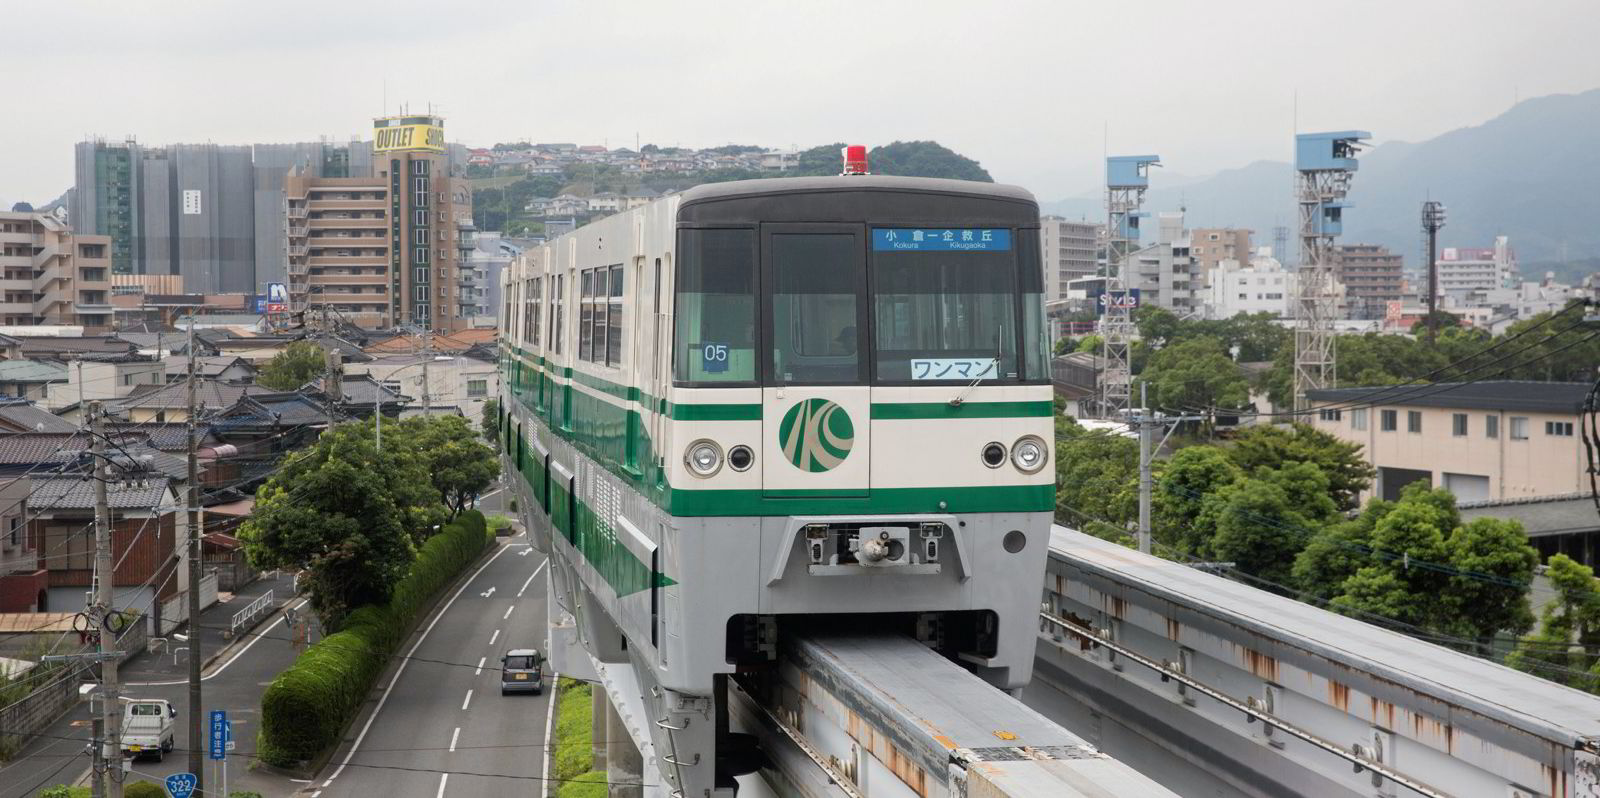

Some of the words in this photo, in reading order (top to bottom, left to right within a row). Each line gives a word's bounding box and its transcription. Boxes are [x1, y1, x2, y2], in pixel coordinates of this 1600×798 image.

[376, 127, 415, 149] OUTLET
[893, 241, 919, 249] Kokura
[949, 241, 986, 250] Kikugaoka
[704, 344, 728, 361] 05
[914, 361, 994, 379] ワンマン
[170, 780, 192, 793] 322
